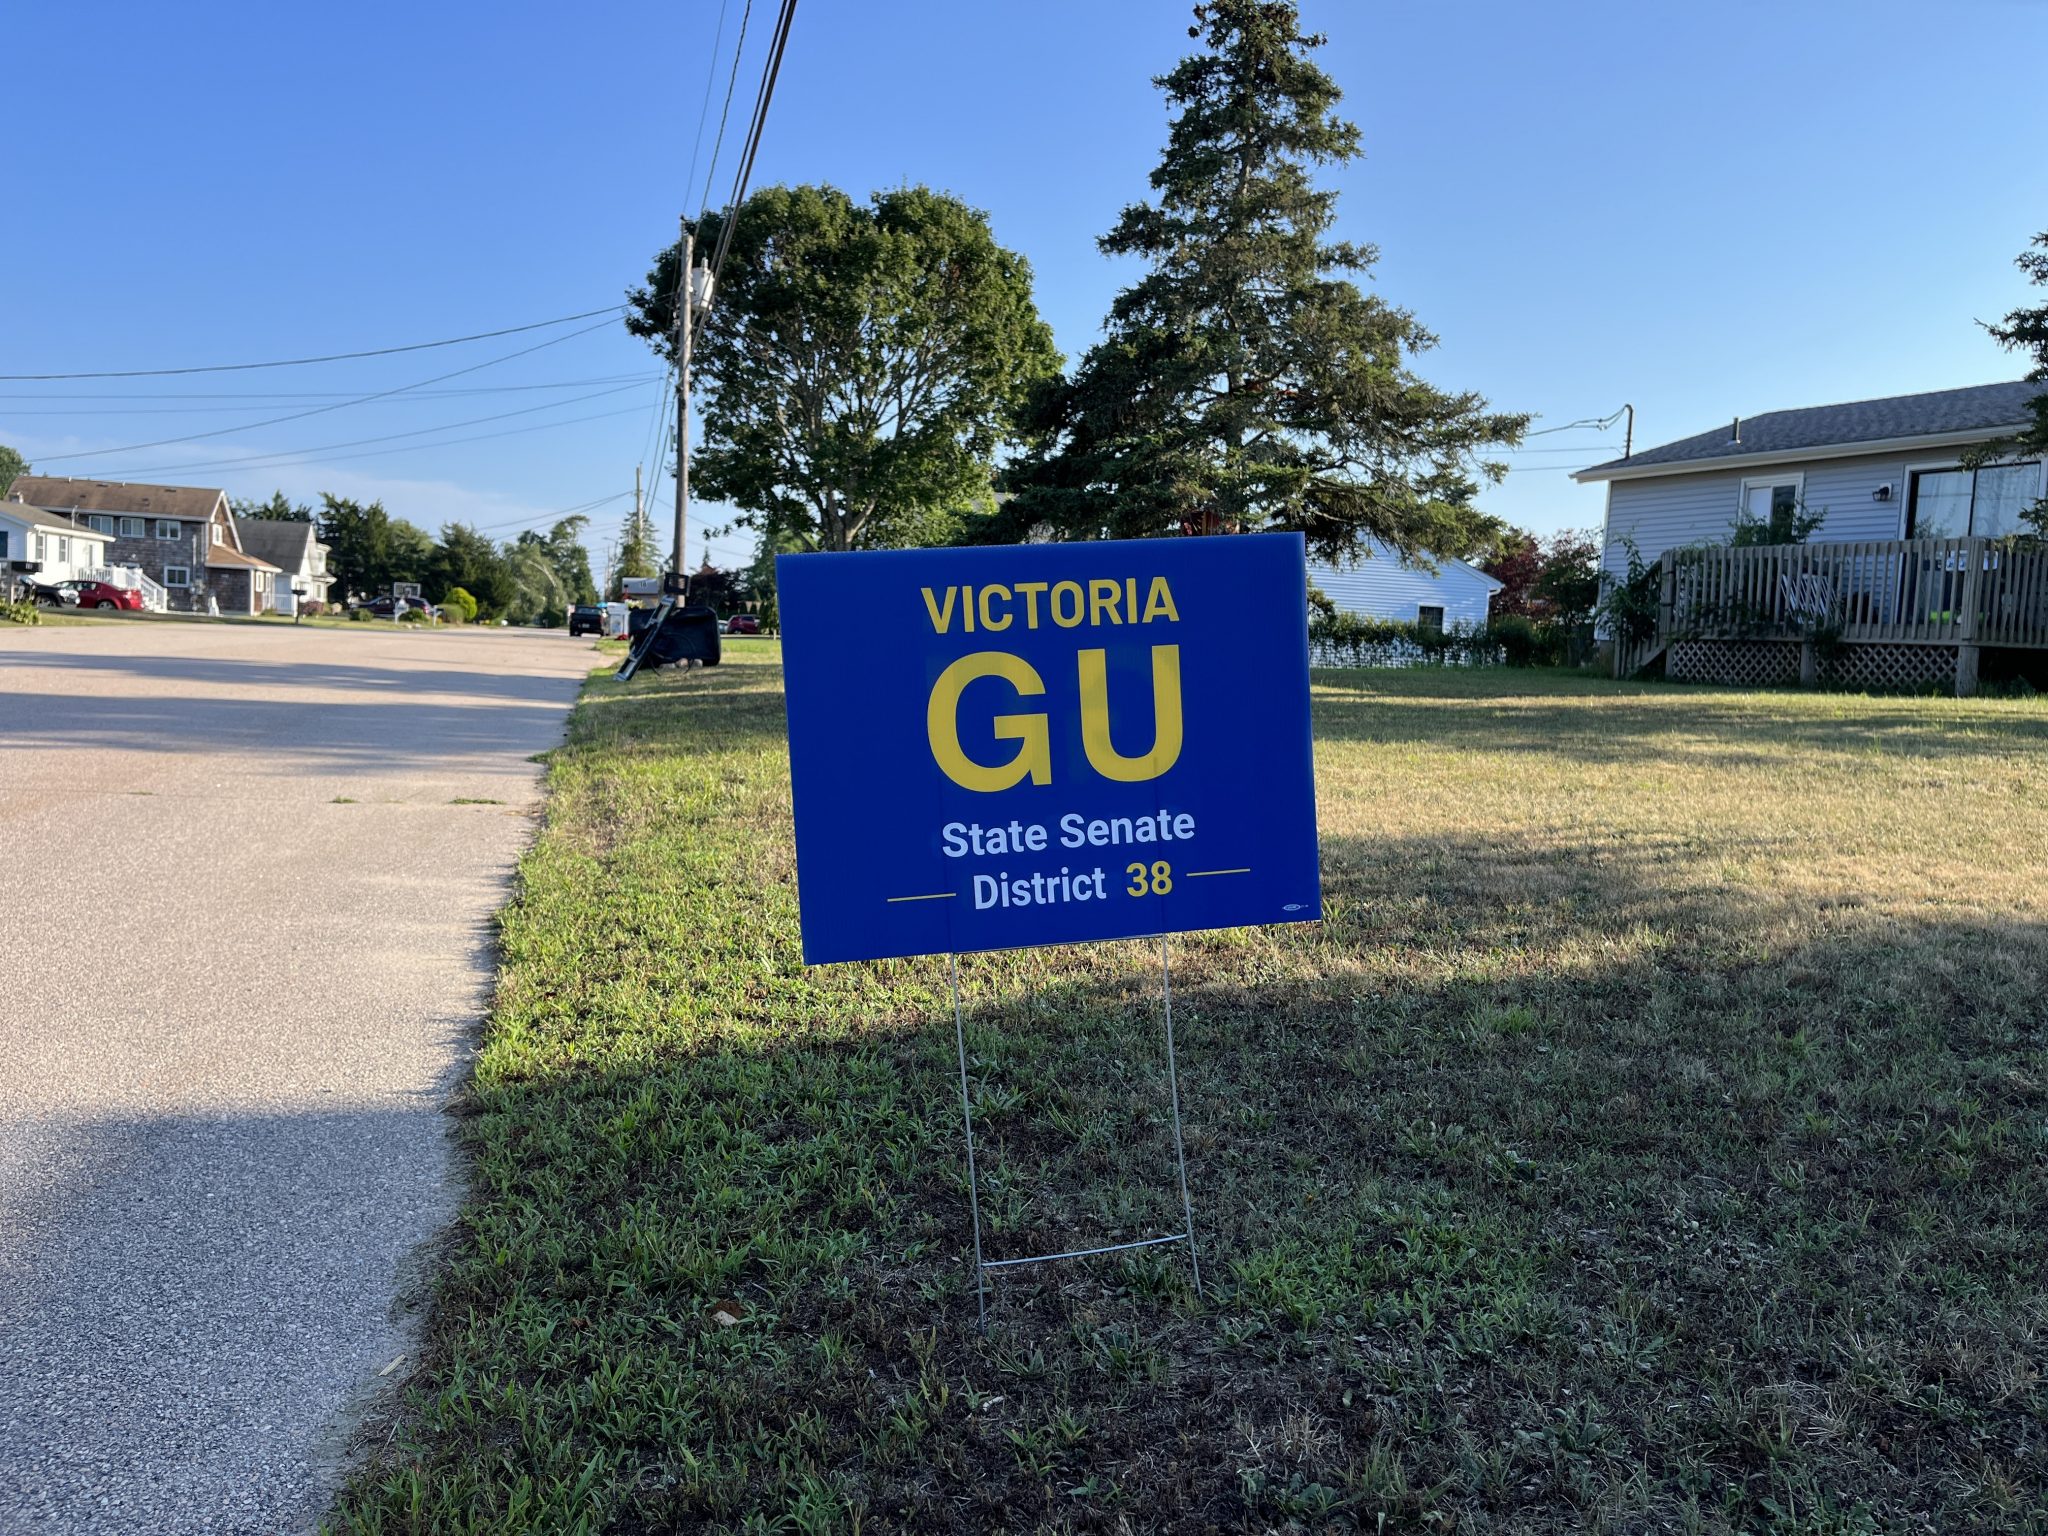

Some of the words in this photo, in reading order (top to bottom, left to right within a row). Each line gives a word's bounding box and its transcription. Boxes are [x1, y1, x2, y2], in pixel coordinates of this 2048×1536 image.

[920, 576, 1180, 634] VICTORIA
[926, 644, 1184, 793] GU
[942, 820, 1048, 858] State
[1060, 809, 1196, 848] Senate
[973, 867, 1107, 910] District
[1126, 860, 1173, 897] 38
